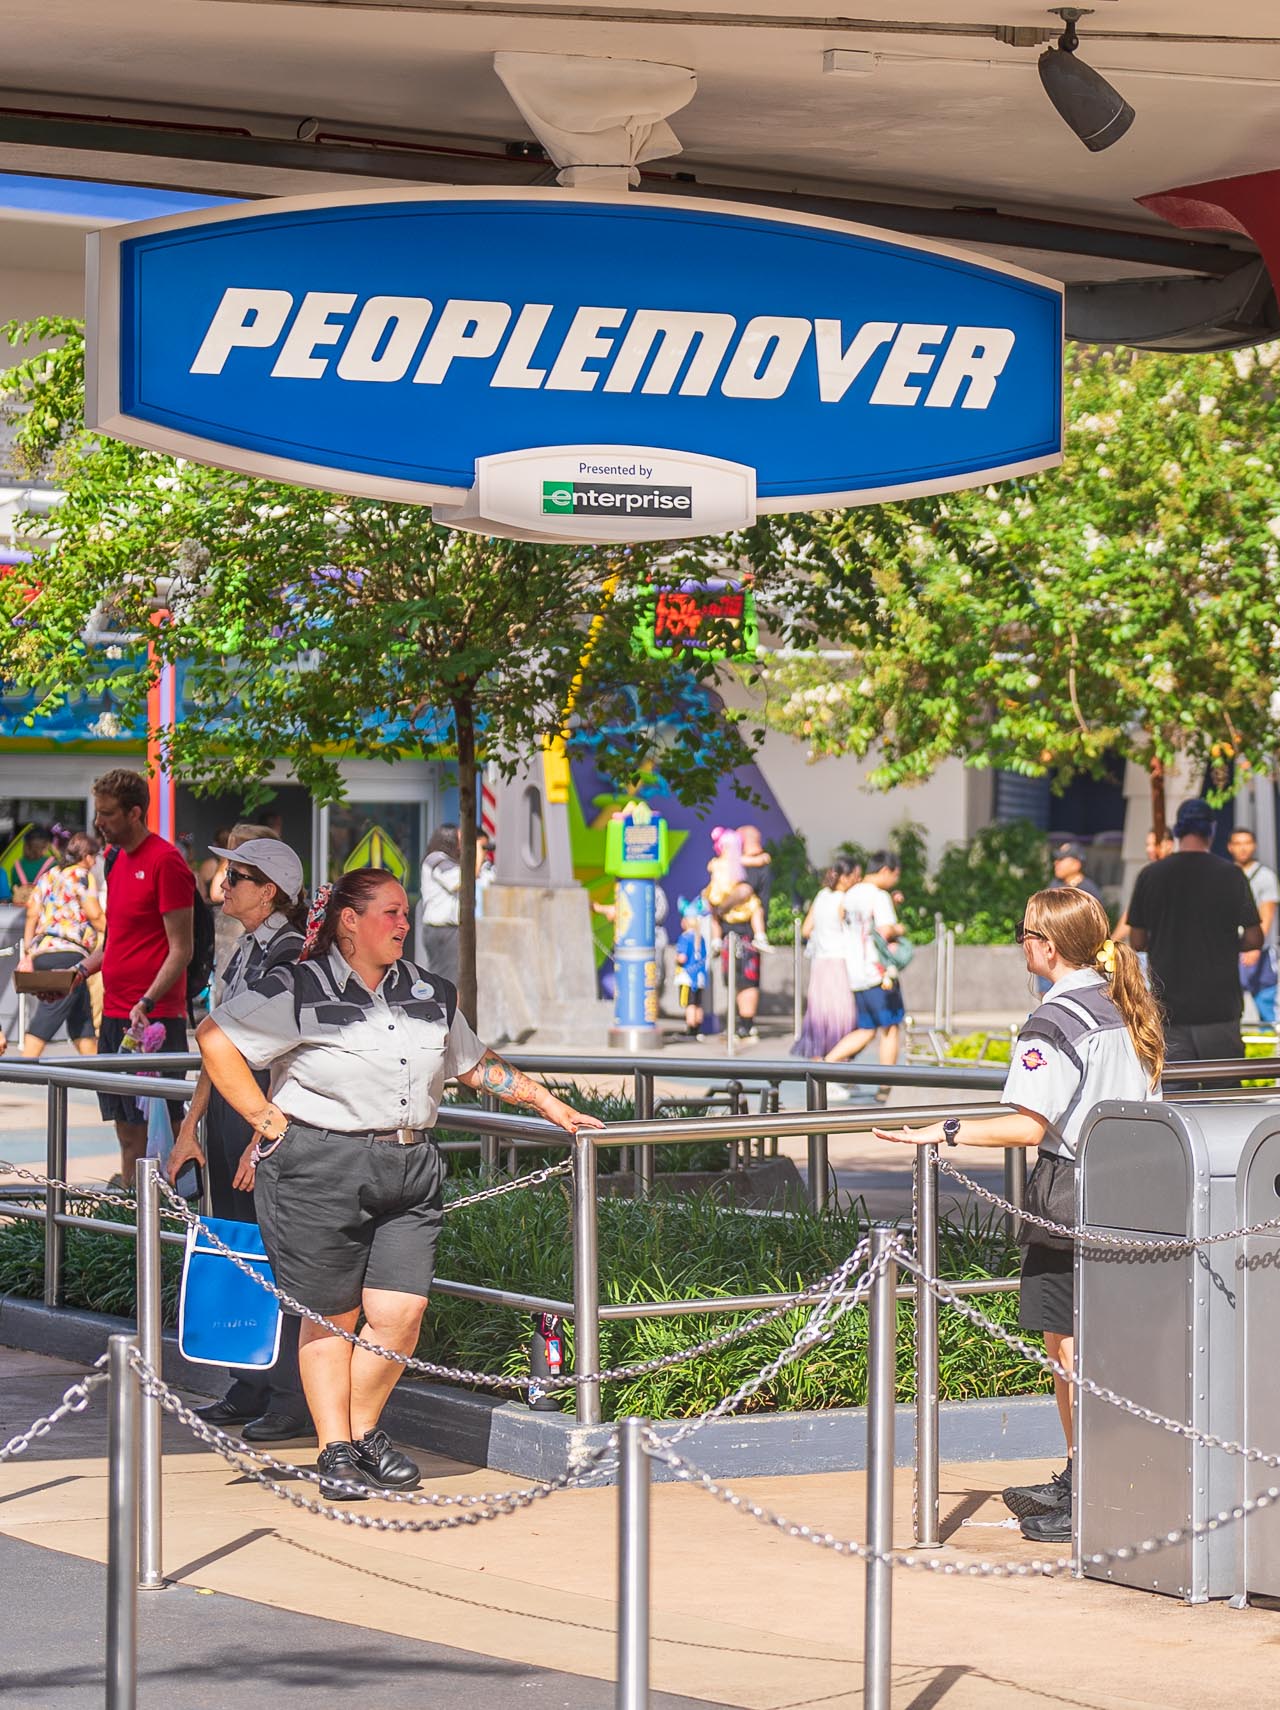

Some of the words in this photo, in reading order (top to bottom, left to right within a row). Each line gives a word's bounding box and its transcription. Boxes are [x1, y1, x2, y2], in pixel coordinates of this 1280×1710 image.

[189, 287, 1016, 409] PEOPLEMOVER
[579, 462, 636, 476] Presented
[639, 464, 653, 479] by
[545, 489, 691, 513] enterprise
